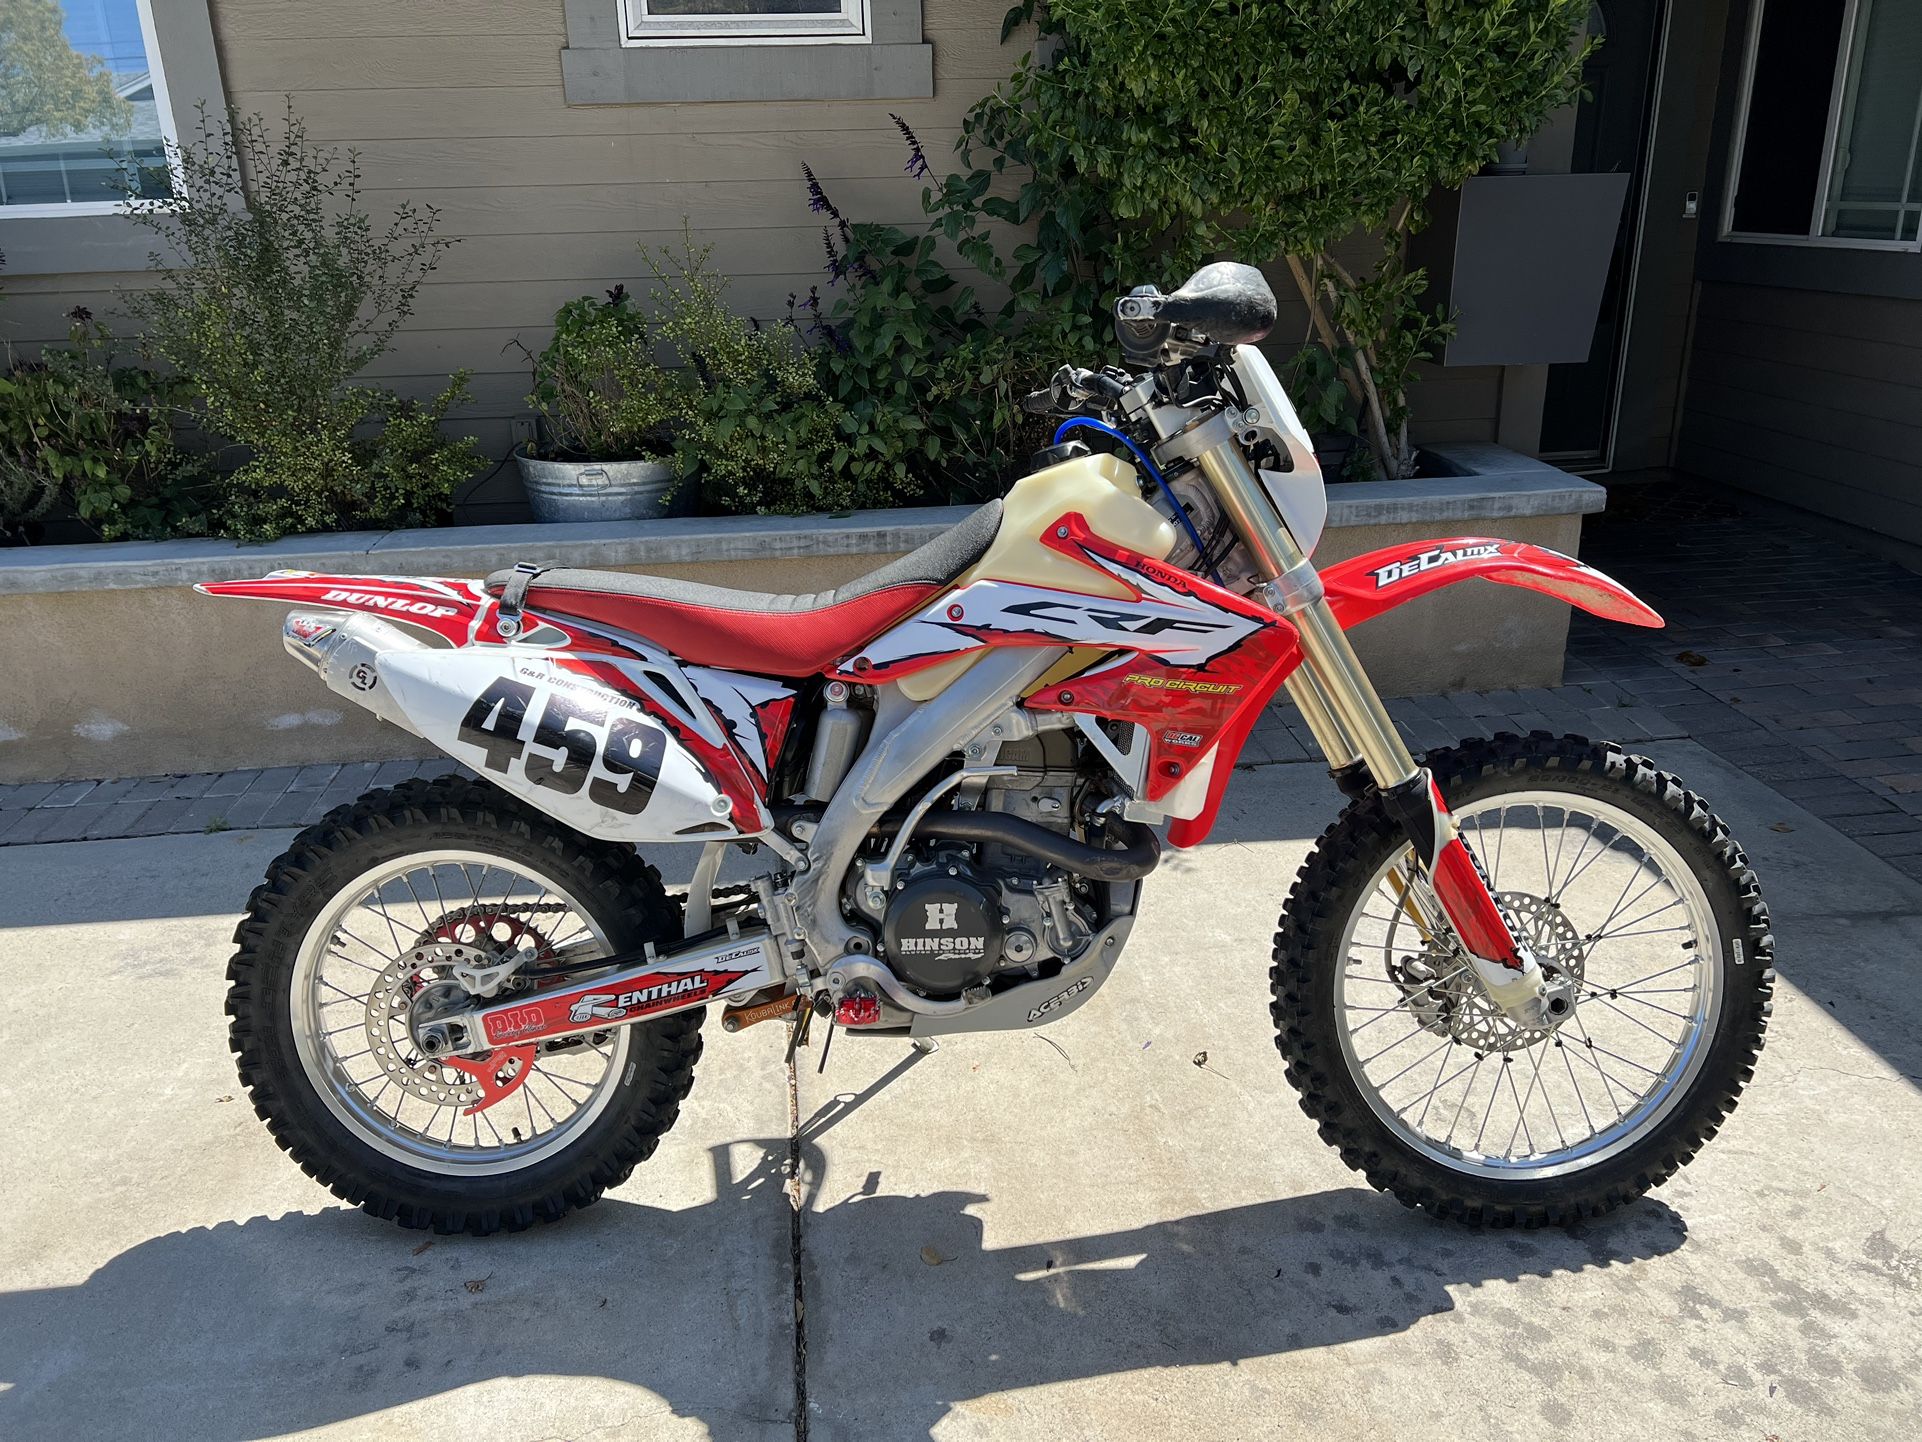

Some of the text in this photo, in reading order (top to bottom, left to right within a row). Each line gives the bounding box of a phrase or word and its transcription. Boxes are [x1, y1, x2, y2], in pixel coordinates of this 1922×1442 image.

[1134, 560, 1187, 588] HONDA
[320, 590, 458, 618] DUNLOP
[1000, 601, 1234, 635] CRF
[547, 676, 636, 710] CONSUCTION
[1124, 673, 1243, 694] PRO CIRCUIT
[457, 675, 667, 815] 459
[925, 903, 958, 930] H
[901, 936, 985, 951] HINSON
[569, 975, 708, 1023] RENTHAL
[629, 989, 706, 1013] CHAINWHEELS
